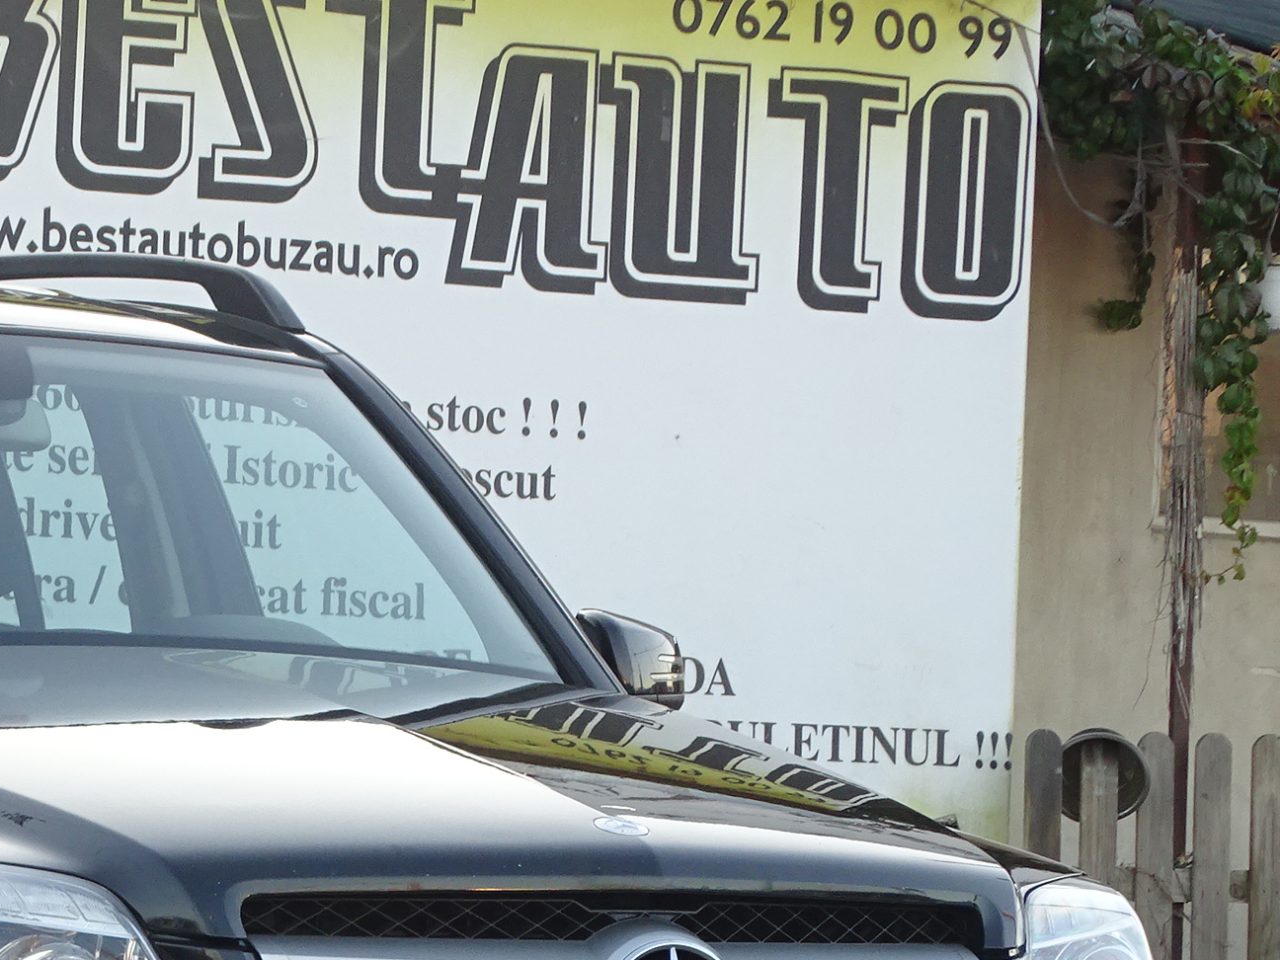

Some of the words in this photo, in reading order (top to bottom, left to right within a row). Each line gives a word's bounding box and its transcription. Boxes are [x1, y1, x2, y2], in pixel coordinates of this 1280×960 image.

[672, 0, 790, 41] 0762
[814, 1, 854, 45] 19
[875, 8, 937, 53] 00
[958, 15, 1012, 60] 99
[445, 44, 1033, 322] AUTO
[426, 395, 506, 435] stoc
[320, 576, 426, 621] fiscal
